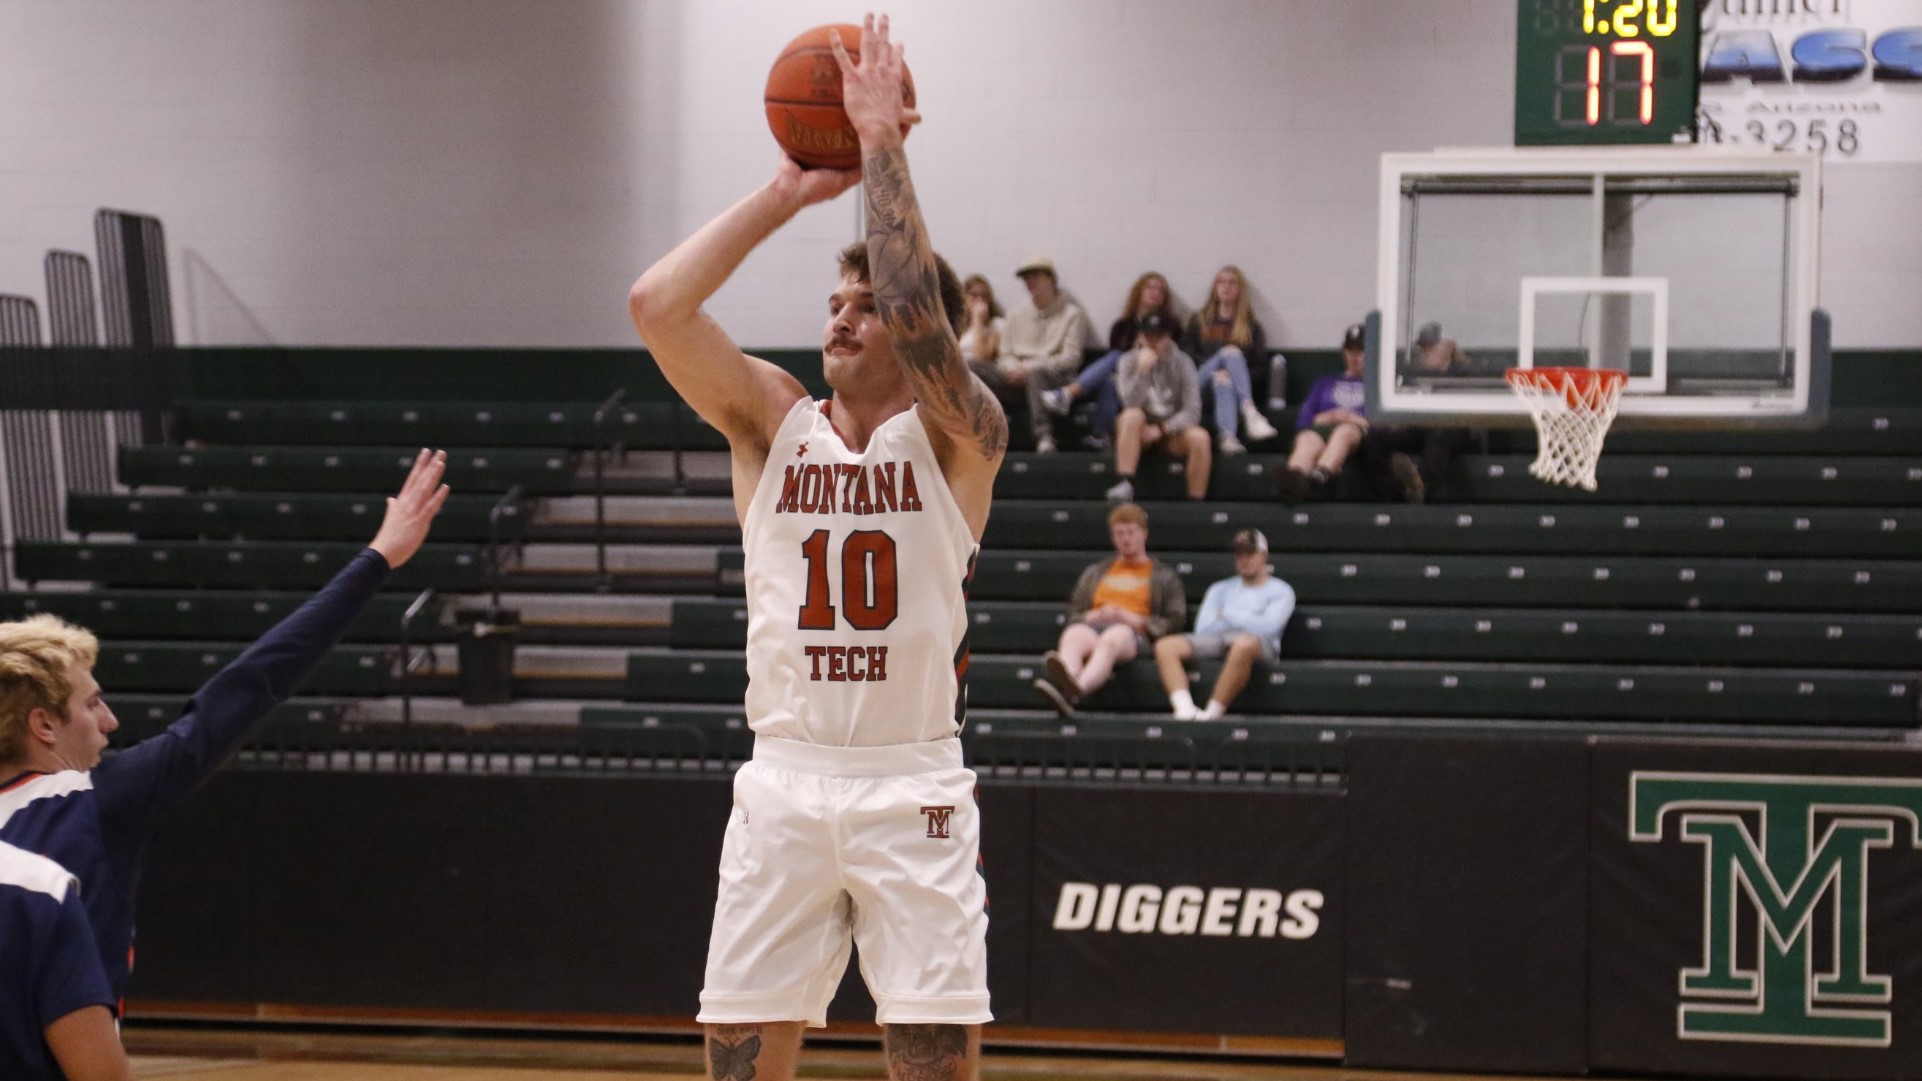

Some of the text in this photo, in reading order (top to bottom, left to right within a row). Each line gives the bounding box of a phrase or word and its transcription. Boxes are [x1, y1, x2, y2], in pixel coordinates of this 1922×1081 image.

[1586, 40, 1654, 126] 17
[775, 460, 923, 515] MONTANA
[797, 528, 898, 630] 10
[804, 646, 888, 682] TECH
[1052, 881, 1325, 940] DIGGERS
